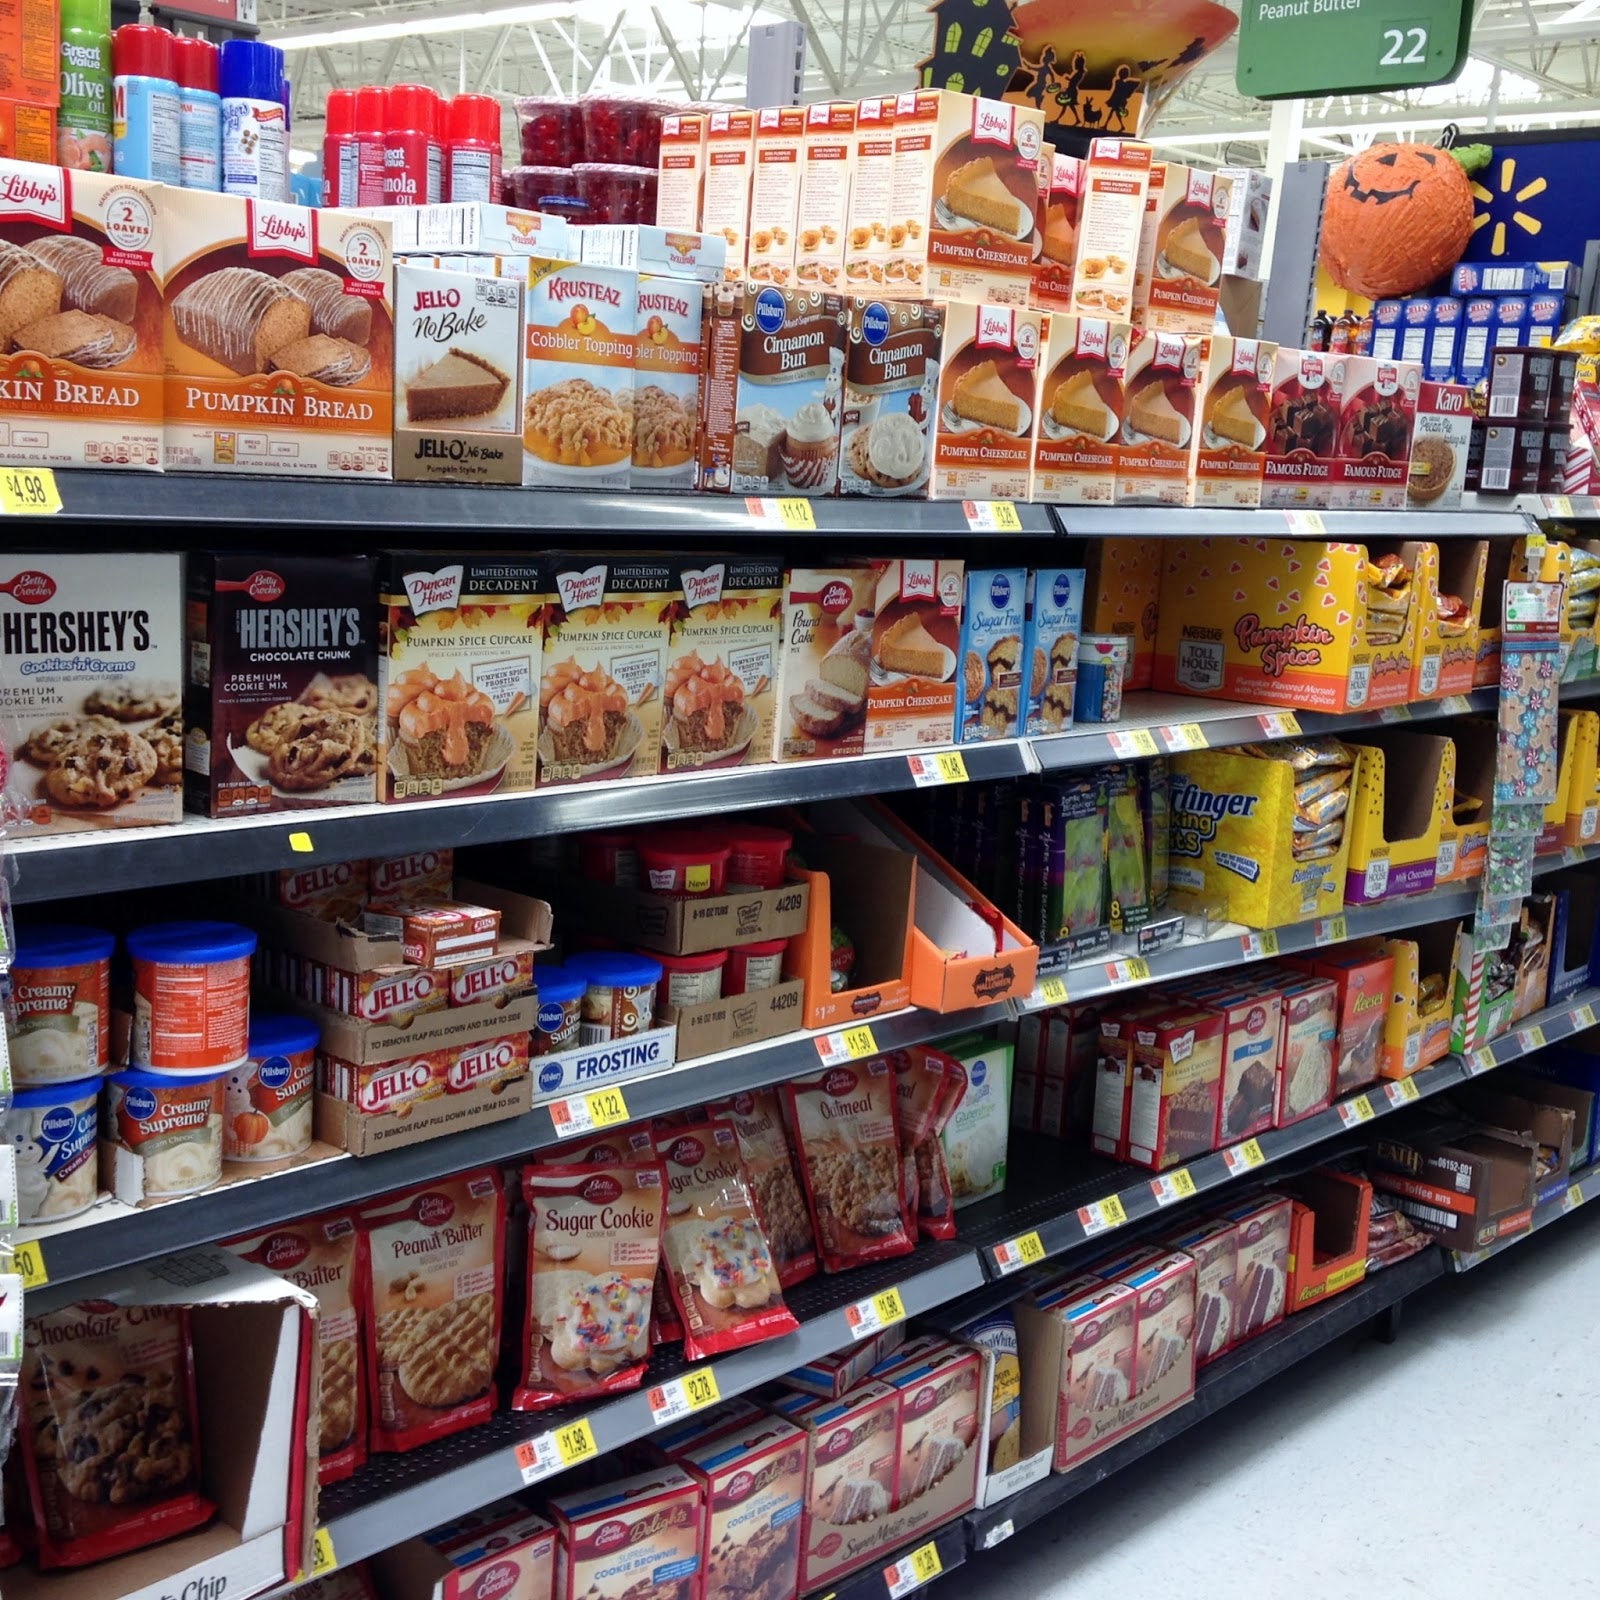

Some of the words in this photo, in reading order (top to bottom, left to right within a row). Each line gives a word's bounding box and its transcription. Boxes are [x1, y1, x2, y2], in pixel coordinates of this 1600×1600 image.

[1259, 1, 1309, 20] Peanut
[61, 42, 101, 60] Great
[1380, 28, 1428, 66] 22
[69, 55, 101, 69] Value
[59, 71, 104, 98] Olive
[89, 102, 107, 115] OIL
[979, 113, 1008, 140] Libby's
[1, 175, 57, 205] Libby's
[396, 194, 413, 206] OIL
[122, 207, 133, 222] 2
[106, 222, 149, 235] LOAVES
[258, 215, 306, 242] Libby's
[359, 242, 368, 256] 2
[932, 241, 974, 258] PUMPKIN
[976, 247, 1029, 266] CHEESECAKE
[346, 256, 381, 267] LOAVES
[548, 277, 621, 307] KRUSTEAZ
[1153, 289, 1180, 302] PUMPKIN
[757, 302, 784, 319] Pillsbury
[413, 316, 437, 338] No
[434, 307, 488, 342] Bake
[864, 315, 889, 331] Pillsbury
[984, 316, 1008, 337] Libby's
[531, 331, 581, 351] Cobbler
[584, 336, 633, 358] Topping
[764, 331, 824, 354] Cinnamon
[1082, 329, 1104, 347] Libby's
[656, 343, 698, 365] Topping
[780, 352, 807, 370] Bun
[869, 342, 923, 364] Cinnamon
[883, 363, 907, 380] Bun
[54, 380, 140, 410] BREAD
[1435, 387, 1462, 412] Karo
[186, 387, 295, 415] PUMPKIN
[303, 396, 373, 421] BREAD
[940, 444, 978, 458] PUMPKIN
[980, 446, 1028, 460] CHEESECAKE
[1039, 452, 1073, 463] PUMPKIN
[1074, 452, 1113, 465] CHEESECAKE
[1119, 456, 1149, 468] PUMPKIN
[1150, 457, 1187, 468] CHEESECAKE
[1200, 458, 1228, 469] PUMPKIN
[1266, 461, 1302, 475] FAMOUS
[1303, 463, 1329, 476] FUDGE
[1344, 463, 1379, 477] FAMOUS
[1380, 466, 1402, 478] FUDGE
[6, 474, 47, 503] $4.98
[471, 568, 504, 577] LIMITED
[505, 568, 538, 576] EDITION
[613, 567, 642, 576] LIMITED
[642, 567, 669, 575] EDITION
[730, 565, 754, 574] LIMITED
[754, 565, 779, 574] EDITION
[20, 574, 48, 589] Betty
[408, 575, 456, 595] Duncan
[469, 580, 539, 591] DECADENT
[563, 575, 601, 592] Duncan
[611, 579, 670, 590] DECADENT
[686, 573, 719, 589] Duncan
[728, 576, 779, 587] DECADENT
[12, 583, 52, 599] Crocker
[249, 583, 282, 597] Crocker
[418, 590, 453, 607] Hines
[571, 588, 598, 604] Hines
[694, 585, 717, 601] Hines
[828, 586, 847, 598] Betty
[991, 585, 1011, 598] Pillsbury
[823, 594, 849, 607] Crocker
[792, 609, 822, 629] Pound
[972, 611, 1002, 632] Sugar
[1003, 611, 1021, 625] Free
[1037, 611, 1063, 631] Sugar
[1063, 611, 1078, 625] Free
[2, 609, 151, 655] HERSHEY'S
[239, 607, 361, 649] HERSHEY'S
[557, 631, 598, 642] PUMPKIN
[601, 631, 625, 641] SPICE
[627, 630, 662, 640] CUPCAKE
[681, 626, 716, 637] PUMPKIN
[720, 625, 740, 635] SPICE
[742, 624, 774, 634] CUPCAKE
[791, 625, 816, 645] Cake
[1235, 613, 1334, 653] Pumpkin
[406, 636, 455, 647] PUMPKIN
[459, 635, 486, 646] SPICE
[489, 635, 533, 645] CUPCAKE
[250, 651, 314, 662] CHOCOLATE
[317, 650, 351, 661] CHUNK
[1189, 645, 1214, 659] TOLL
[1181, 657, 1221, 672] HOUSE
[1261, 647, 1321, 677] Spice
[230, 673, 281, 683] PREMIUM
[476, 672, 507, 682] PUMPKIN
[509, 668, 528, 676] SPICE
[485, 676, 520, 688] FROSTING
[224, 682, 266, 692] COOKIE
[268, 681, 288, 691] MIX
[1236, 677, 1270, 691] Pumpkin
[1271, 680, 1302, 693] Flavored
[1303, 685, 1336, 696] Morsels
[867, 697, 905, 710] PUMPKIN
[906, 694, 953, 707] CHEESECAKE
[1234, 686, 1249, 695] with
[1250, 688, 1291, 701] Cinnamon
[1292, 692, 1306, 702] and
[1307, 695, 1335, 706] Spices
[1368, 872, 1387, 882] HOUSE
[1372, 865, 1386, 874] TOLL
[1395, 873, 1406, 882] Milk
[1407, 868, 1434, 881] Chocolate
[775, 894, 802, 913] 44209
[18, 985, 75, 998] Creamy
[770, 993, 798, 1011] 44209
[538, 1012, 564, 1022] Pillsbury
[370, 1039, 380, 1050] TO
[382, 1033, 412, 1048] REMOVE
[412, 1031, 428, 1042] FLAP
[429, 1028, 443, 1039] PULL
[444, 1024, 466, 1036] DOWN
[467, 1020, 482, 1032] AND
[482, 1016, 498, 1028] TEAR
[499, 1014, 507, 1025] TO
[507, 1012, 521, 1024] SIDE
[576, 1042, 660, 1080] FROSTING
[260, 1066, 291, 1077] Pillsbury
[125, 1095, 156, 1110] Pillsbury
[161, 1099, 211, 1117] Creamy
[593, 1094, 621, 1115] $1.22
[821, 1092, 873, 1120] Oatmeal
[43, 1118, 74, 1130] Pillsbury
[138, 1111, 208, 1136] Supreme
[373, 1131, 382, 1141] TO
[383, 1123, 413, 1138] REMOVE
[414, 1120, 429, 1132] FLAP
[430, 1115, 444, 1128] PULL
[445, 1111, 467, 1124] DOWN
[467, 1106, 482, 1118] AND
[483, 1101, 498, 1114] TEAR
[498, 1099, 507, 1110] TO
[507, 1096, 520, 1108] SIDE
[58, 1156, 83, 1178] Cream
[1438, 1157, 1472, 1175] 06152-001
[668, 1173, 694, 1194] ugar
[1405, 1183, 1433, 1199] Toffee
[1435, 1193, 1451, 1204] BITS
[421, 1198, 444, 1210] Betty
[546, 1209, 598, 1237] Sugar
[600, 1206, 654, 1231] Cookie
[392, 1231, 440, 1258] Peanut
[442, 1222, 485, 1247] Butter
[292, 1264, 345, 1290] Butter
[25, 1313, 121, 1348] Chocolate
[689, 1378, 713, 1400] $2.78
[563, 1429, 588, 1454] $1.98
[629, 1509, 687, 1543] Delights
[726, 1512, 756, 1529] COOKIE
[596, 1529, 626, 1547] Crocker
[601, 1525, 622, 1538] Betty
[594, 1561, 632, 1580] COOKIE
[633, 1547, 679, 1567] BROWNIE
[181, 1574, 227, 1600] Chip
